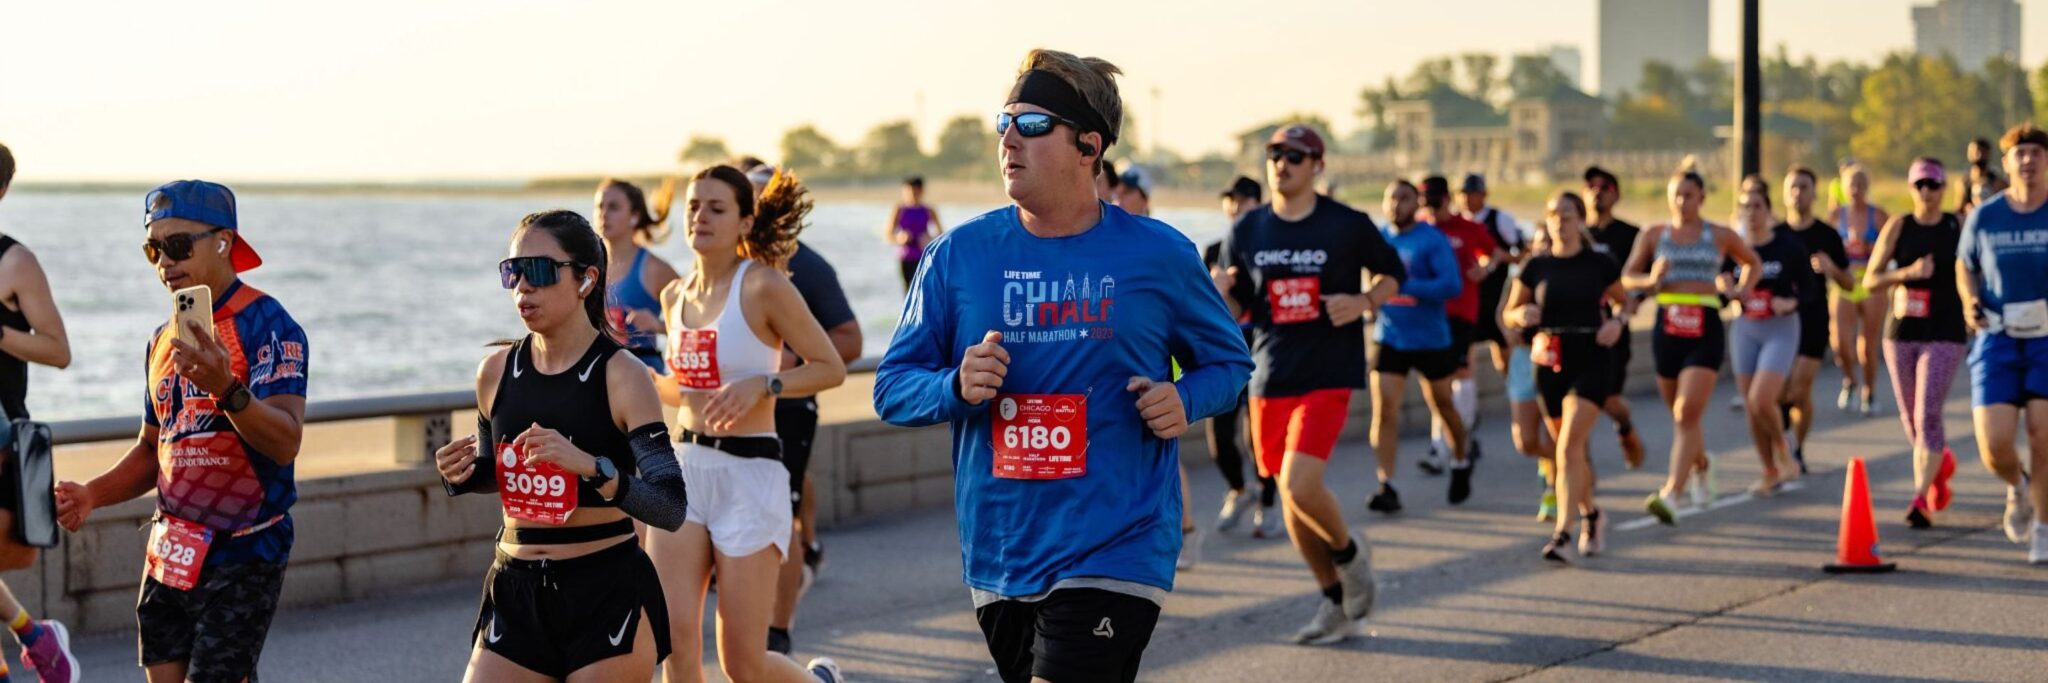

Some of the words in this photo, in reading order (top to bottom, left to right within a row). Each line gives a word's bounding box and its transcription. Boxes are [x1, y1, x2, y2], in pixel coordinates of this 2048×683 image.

[1254, 249, 1328, 266] CHICAGO
[1003, 331, 1027, 343] HALF
[1028, 328, 1077, 343] MARATHON
[1019, 405, 1051, 413] CHICAGO
[1004, 425, 1071, 450] 6180
[503, 471, 566, 497] 3099
